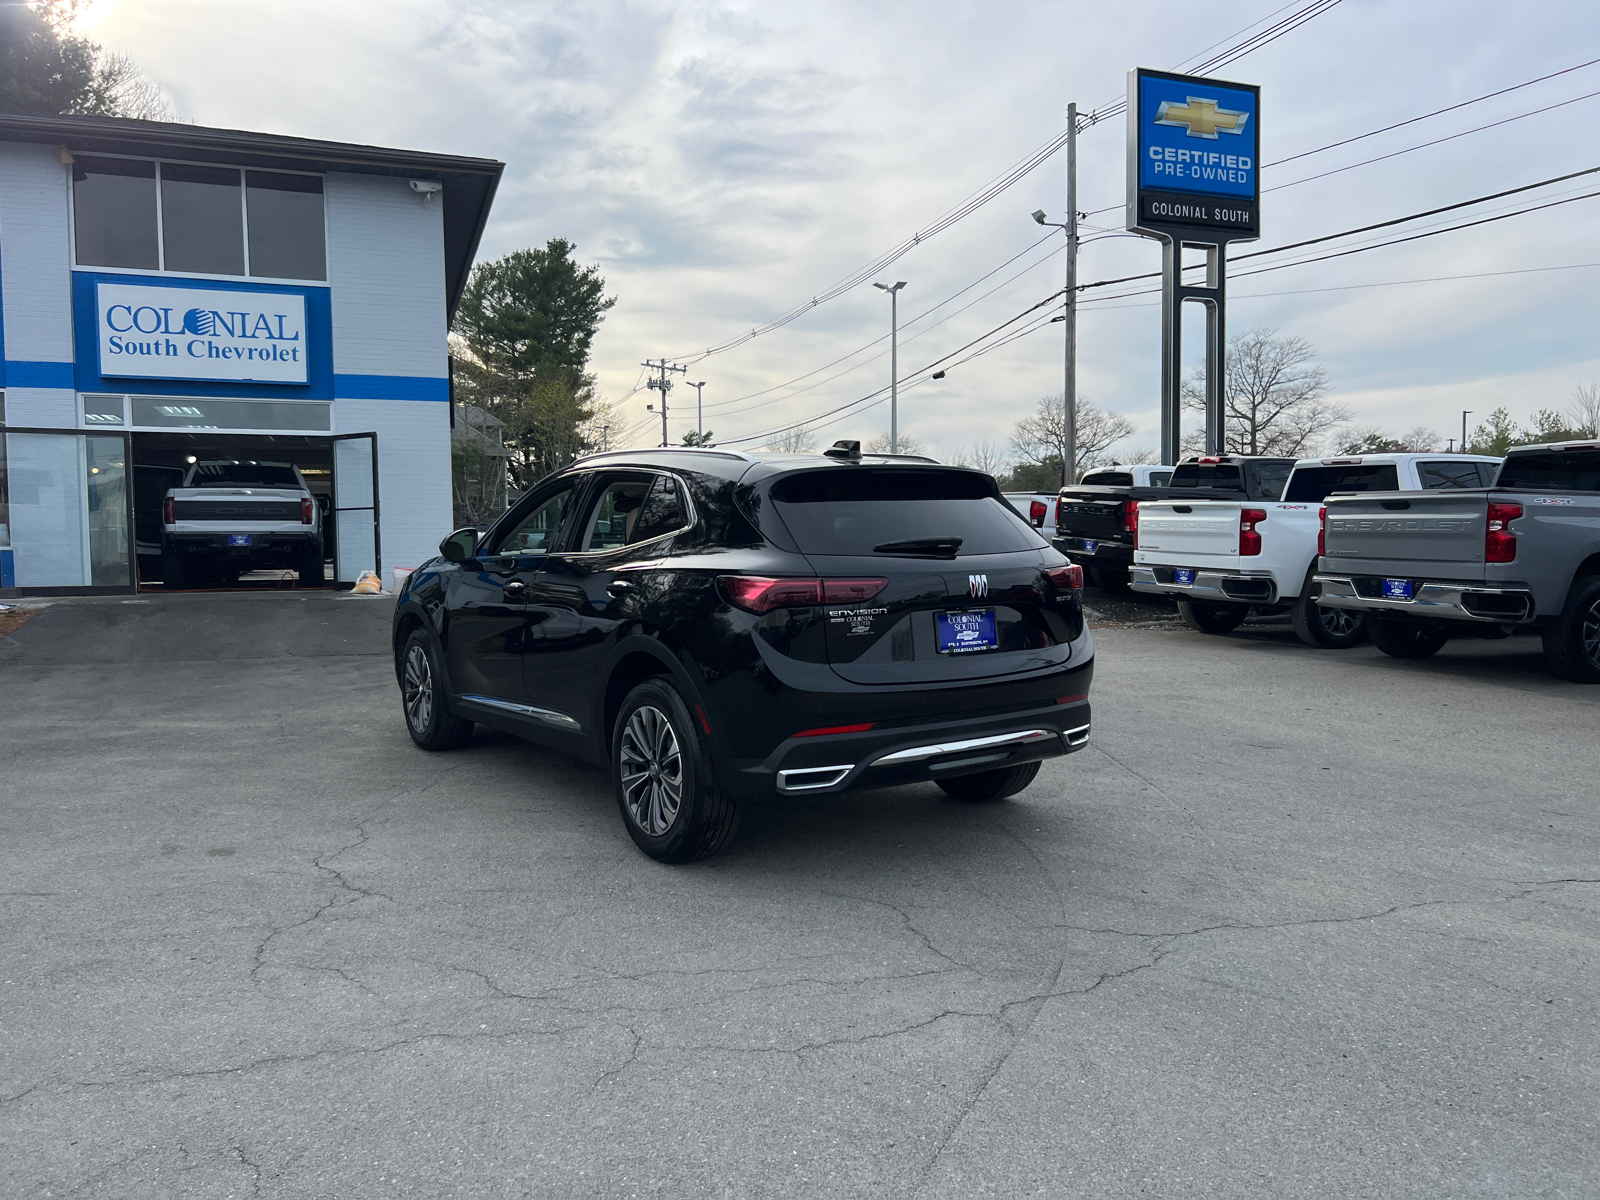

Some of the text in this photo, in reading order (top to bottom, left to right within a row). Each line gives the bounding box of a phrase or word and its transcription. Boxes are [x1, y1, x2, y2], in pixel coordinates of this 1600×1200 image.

[1149, 146, 1251, 169] CERTIFIED
[1154, 161, 1247, 183] PRE-OWNED
[1152, 202, 1249, 222] COLONIAL SOUTH
[106, 304, 299, 341] COLONIAL
[109, 335, 300, 362] South Chevrolet
[190, 507, 287, 515] FORD
[1141, 521, 1230, 531] CHEVROLET
[1331, 520, 1471, 531] CHEVROLET
[947, 614, 984, 625] COLONIAL
[954, 622, 979, 631] SOUTH
